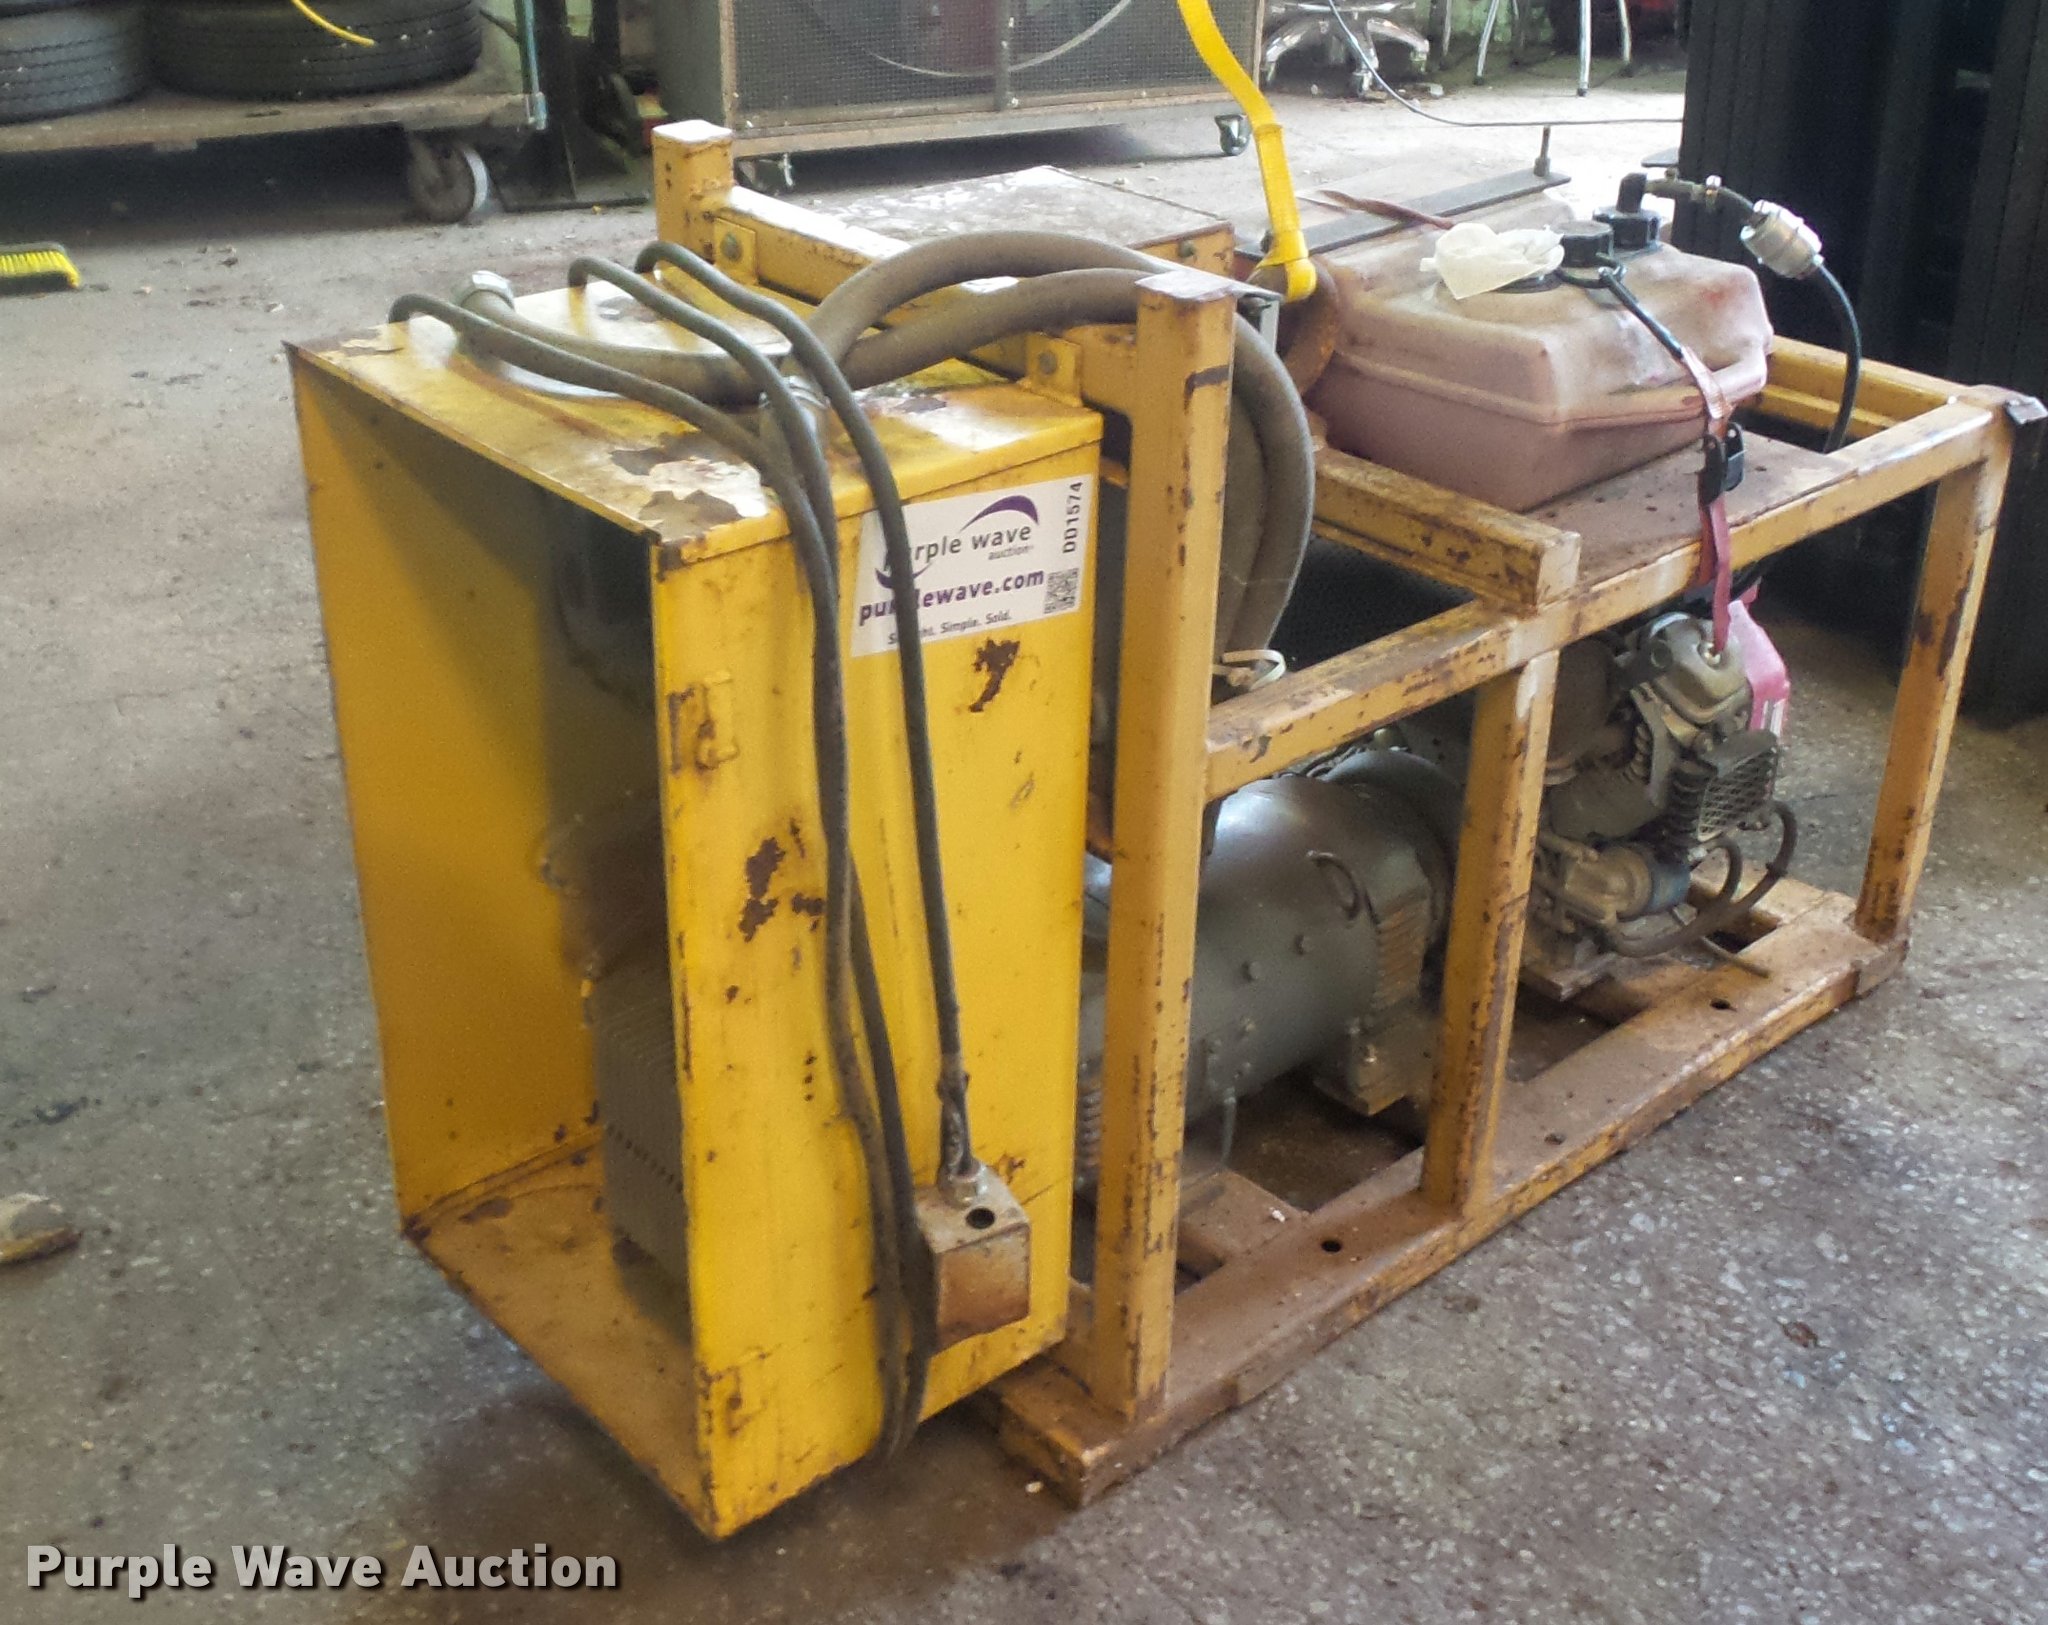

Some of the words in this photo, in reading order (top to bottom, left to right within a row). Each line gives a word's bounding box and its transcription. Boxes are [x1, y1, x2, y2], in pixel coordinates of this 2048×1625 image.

[1063, 482, 1083, 554] DD1574
[971, 525, 1032, 551] wave
[987, 545, 1030, 561] auction
